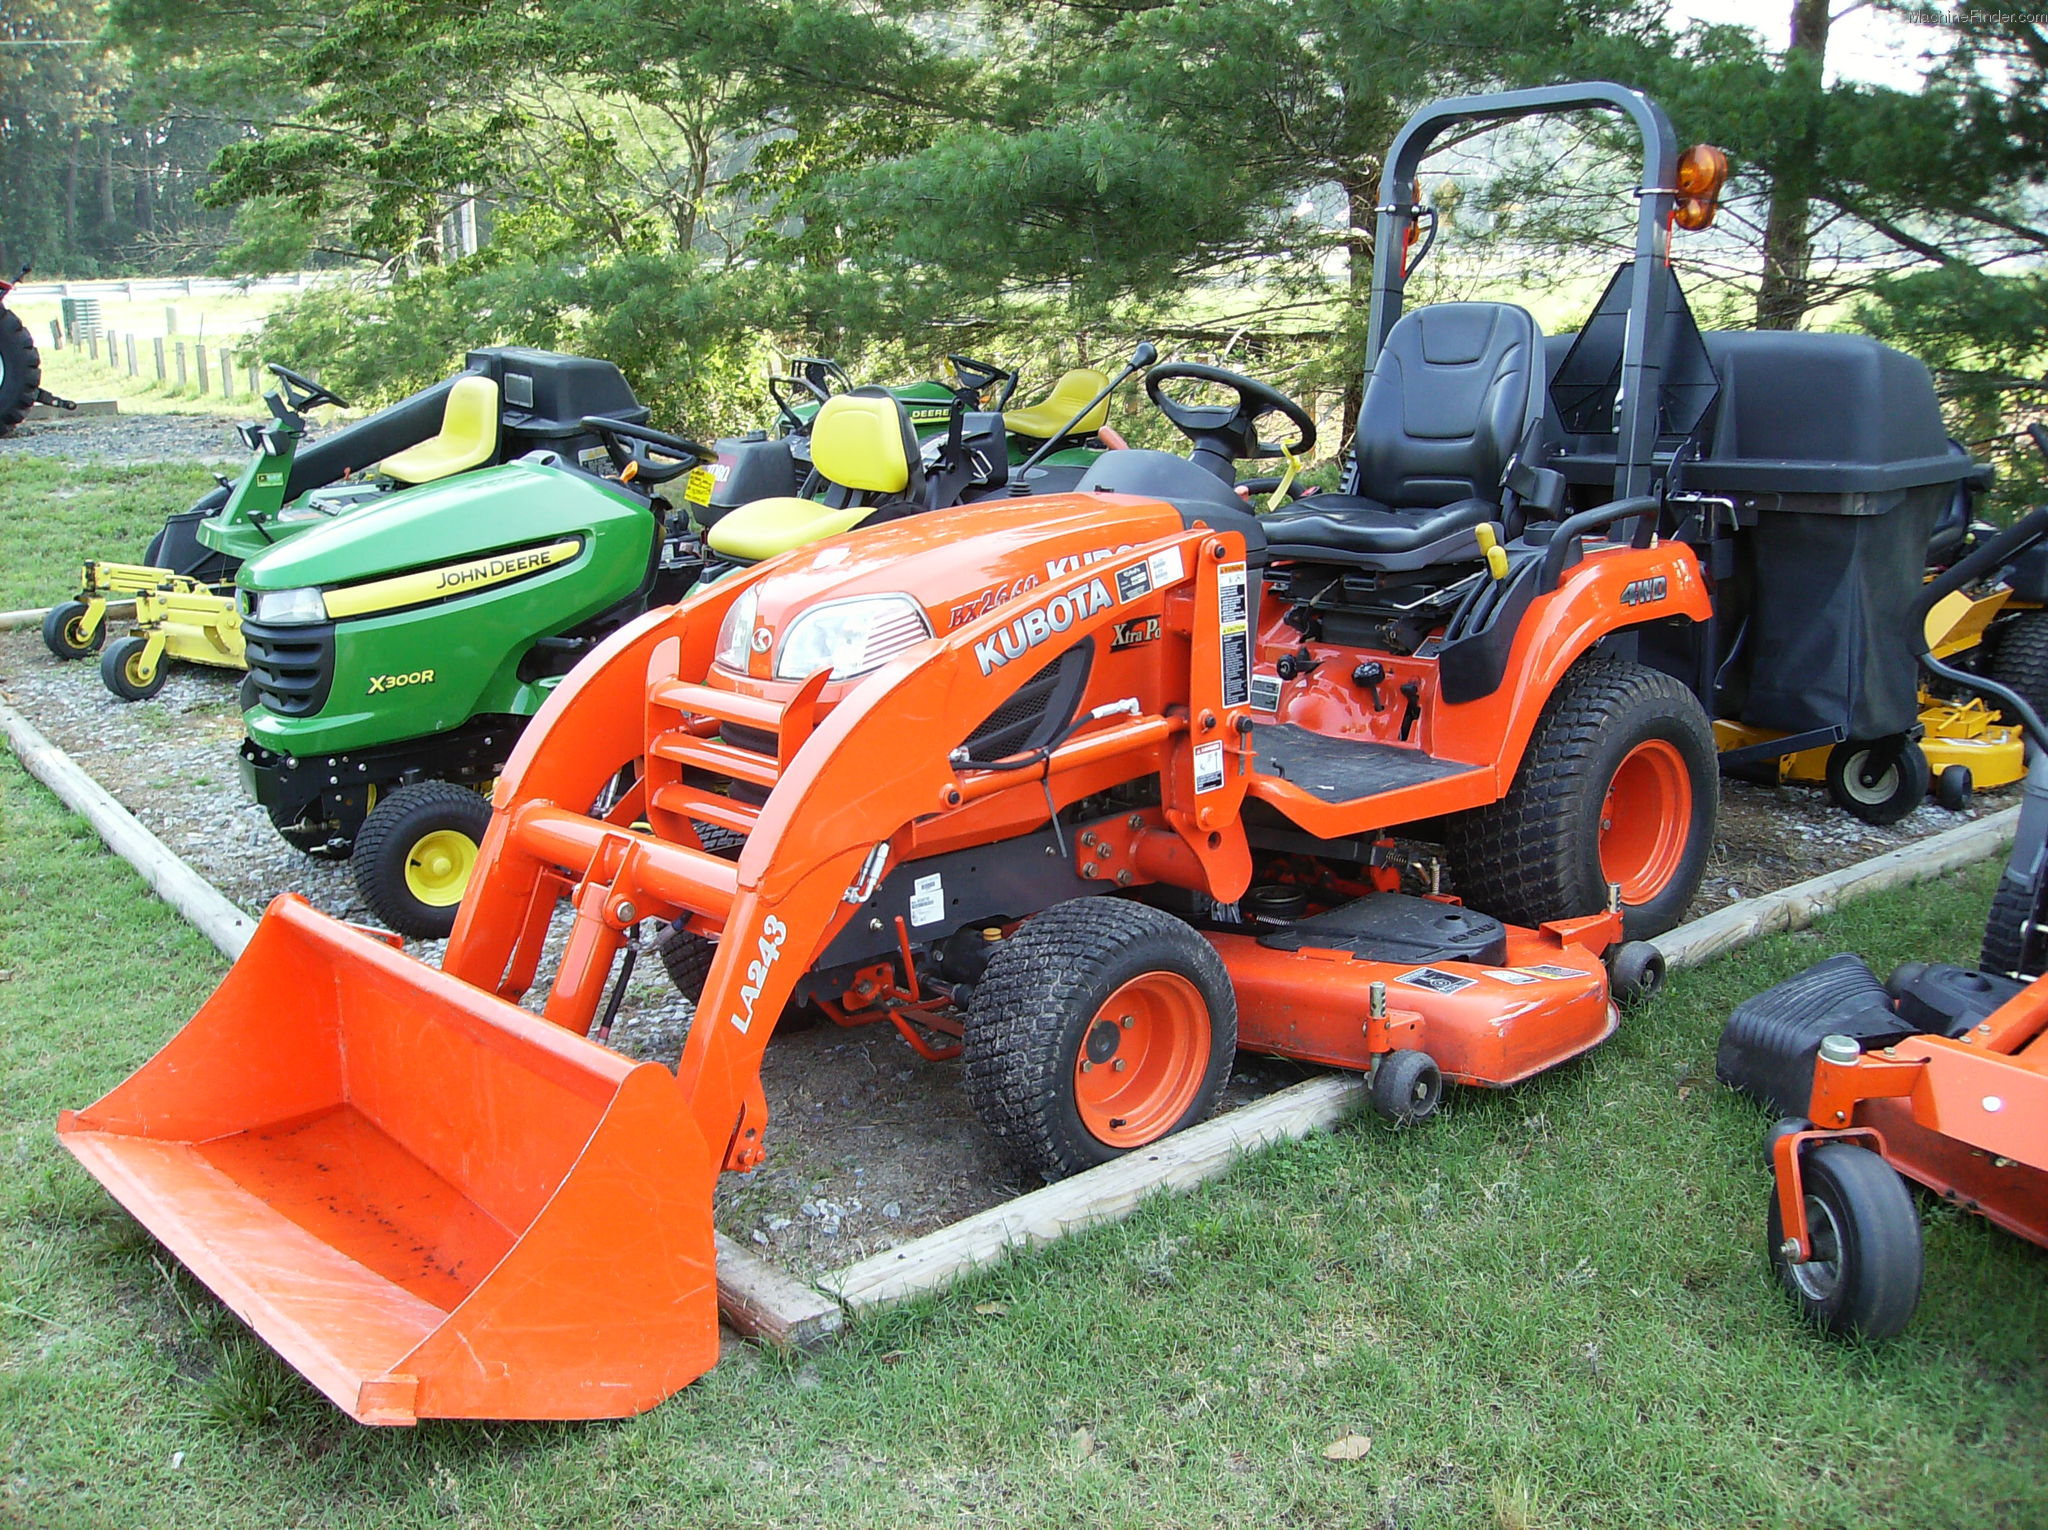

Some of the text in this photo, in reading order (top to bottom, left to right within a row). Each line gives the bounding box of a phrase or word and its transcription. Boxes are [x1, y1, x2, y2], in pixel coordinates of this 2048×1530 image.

[912, 408, 950, 419] DEERE
[436, 551, 552, 590] JOHN DEERE
[1620, 576, 1667, 606] 4WD
[974, 577, 1114, 677] KUBOTA
[1110, 622, 1143, 647] Xtra
[366, 669, 435, 695] X300R
[730, 914, 787, 1035] LA243
